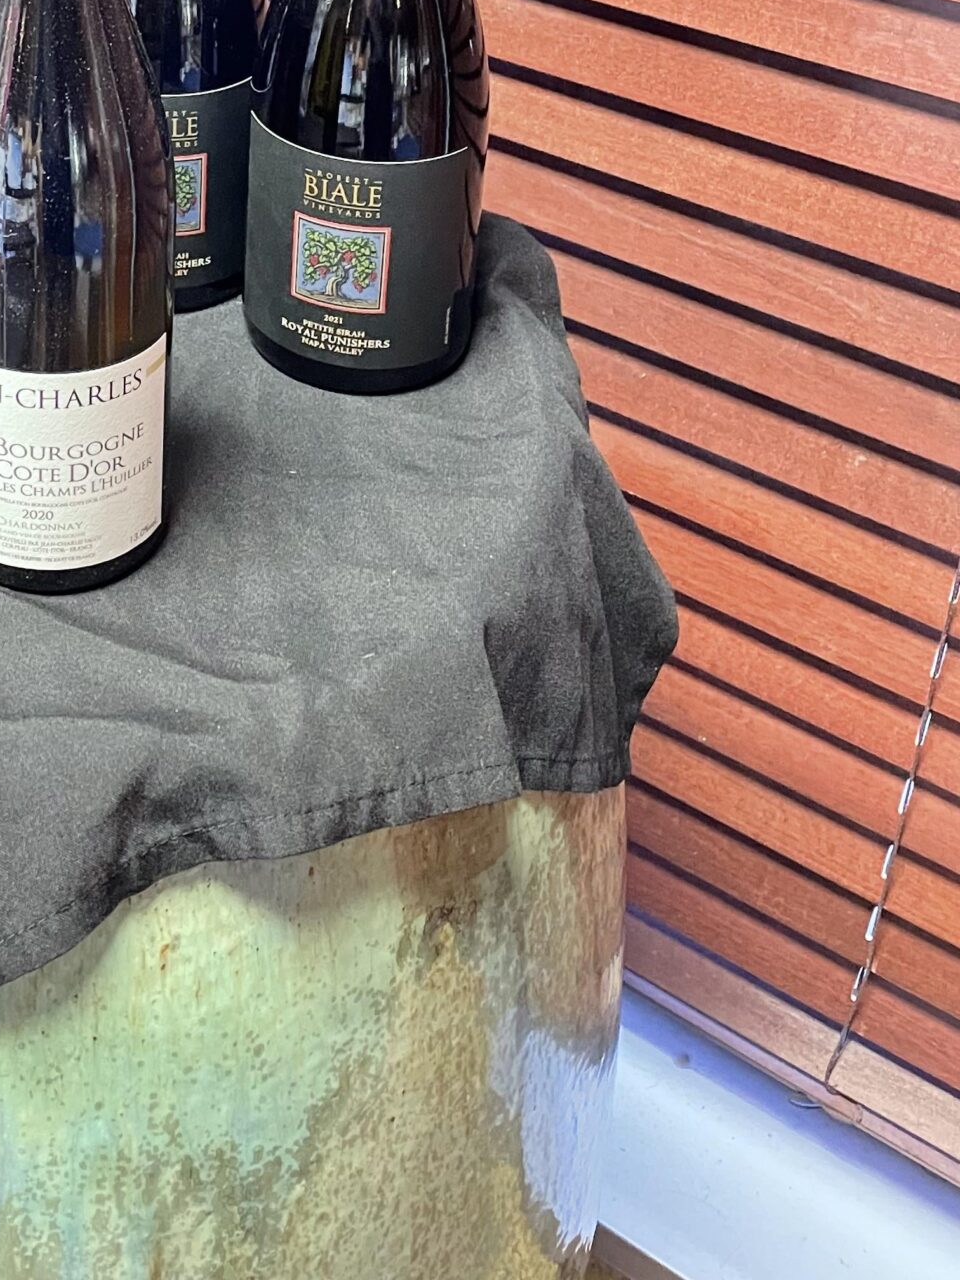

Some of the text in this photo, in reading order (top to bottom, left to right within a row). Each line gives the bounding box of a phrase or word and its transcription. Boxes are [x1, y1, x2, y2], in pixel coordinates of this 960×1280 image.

[165, 110, 187, 118] ERT
[317, 170, 369, 185] ROBERT
[304, 173, 382, 208] BIALE
[303, 199, 381, 219] VINEYARDS
[174, 256, 211, 269] SHERS
[323, 314, 343, 325] 2021
[281, 317, 390, 349] ROYAL PUNISHERS
[302, 319, 366, 338] PETITE SIRAH
[301, 337, 364, 356] NAPA VALLEY
[69, 456, 125, 483] D'OR
[20, 484, 86, 497] CHAMPS
[22, 509, 54, 521] 2020
